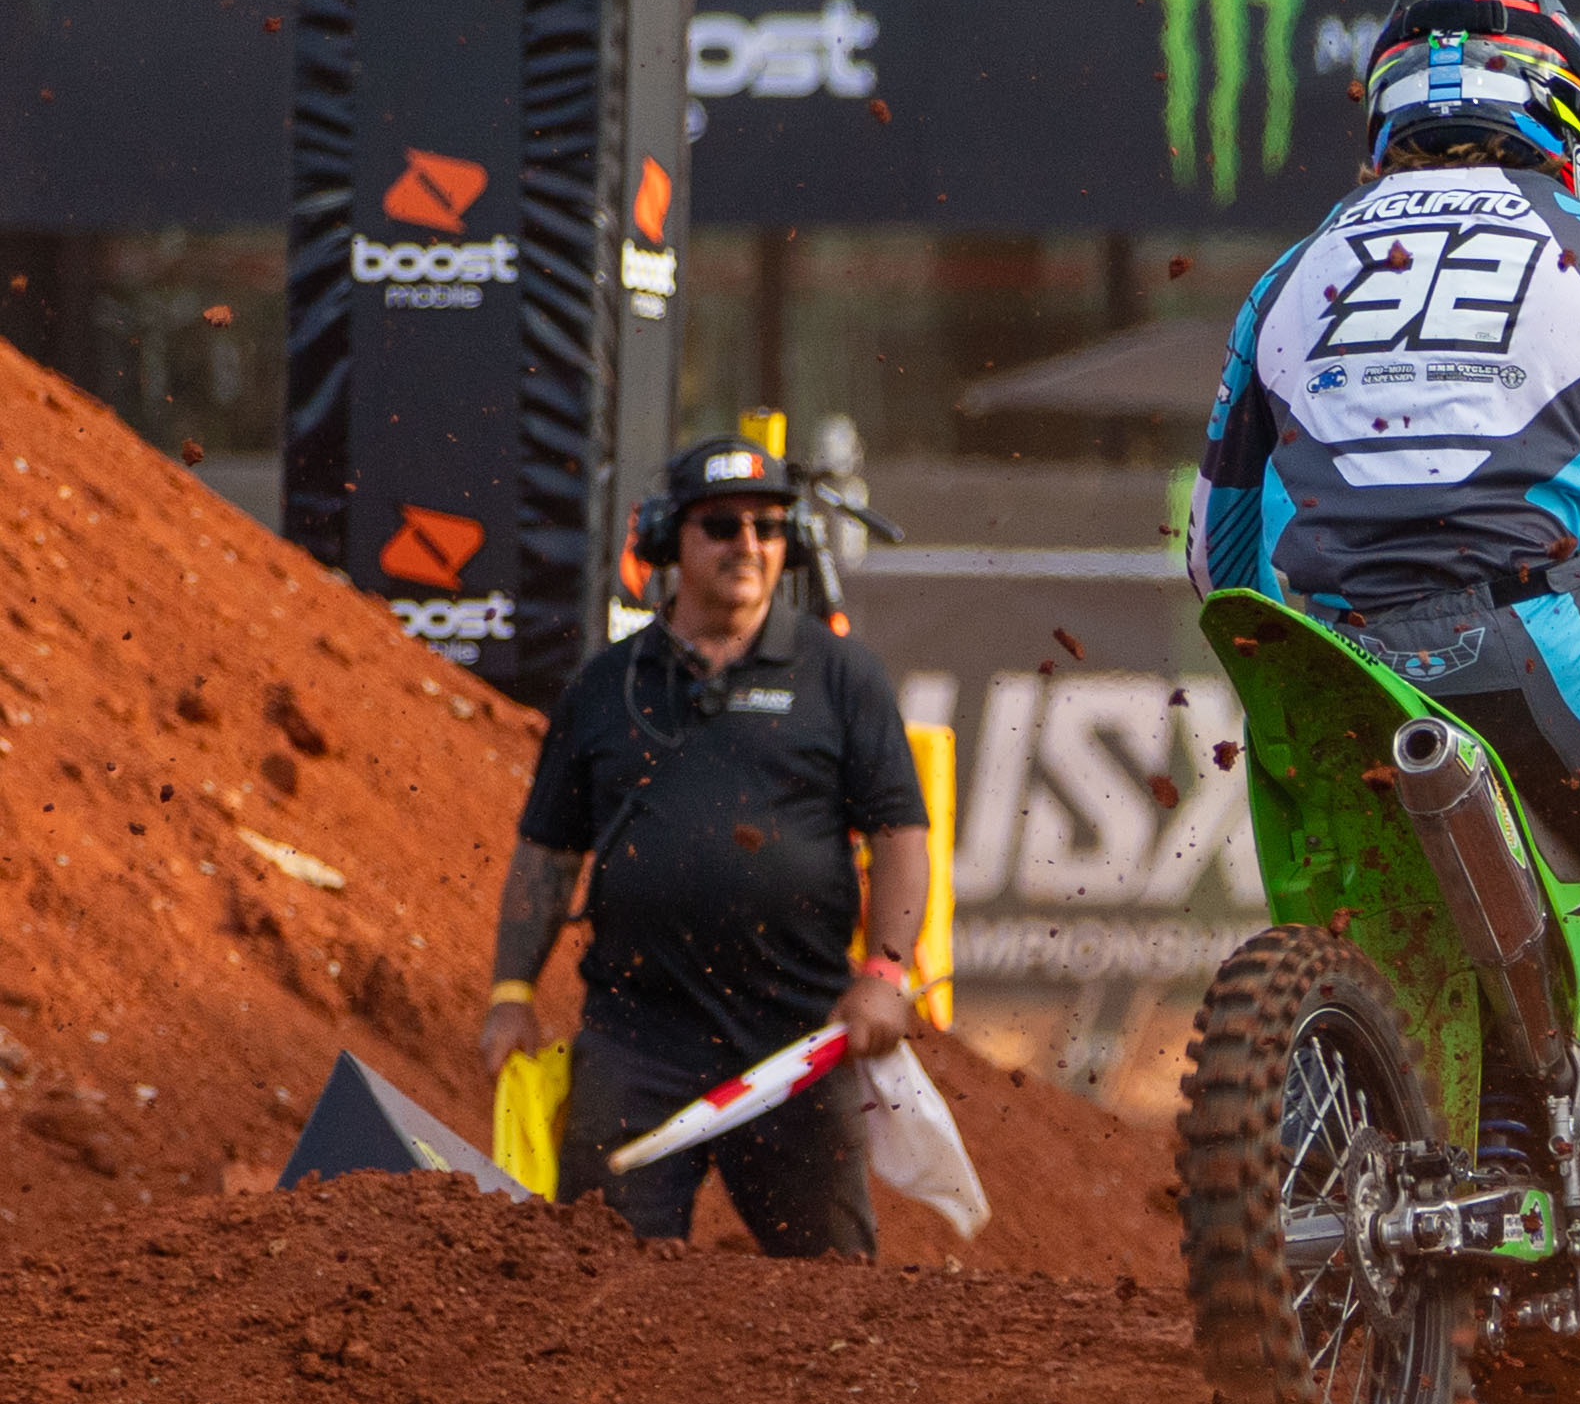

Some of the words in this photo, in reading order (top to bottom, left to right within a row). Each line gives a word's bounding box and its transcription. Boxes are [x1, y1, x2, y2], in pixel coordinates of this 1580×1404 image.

[352, 235, 519, 283] boost
[385, 285, 482, 309] mobile
[1305, 224, 1551, 361] 32
[388, 592, 516, 639] oost
[900, 670, 1270, 905] USX
